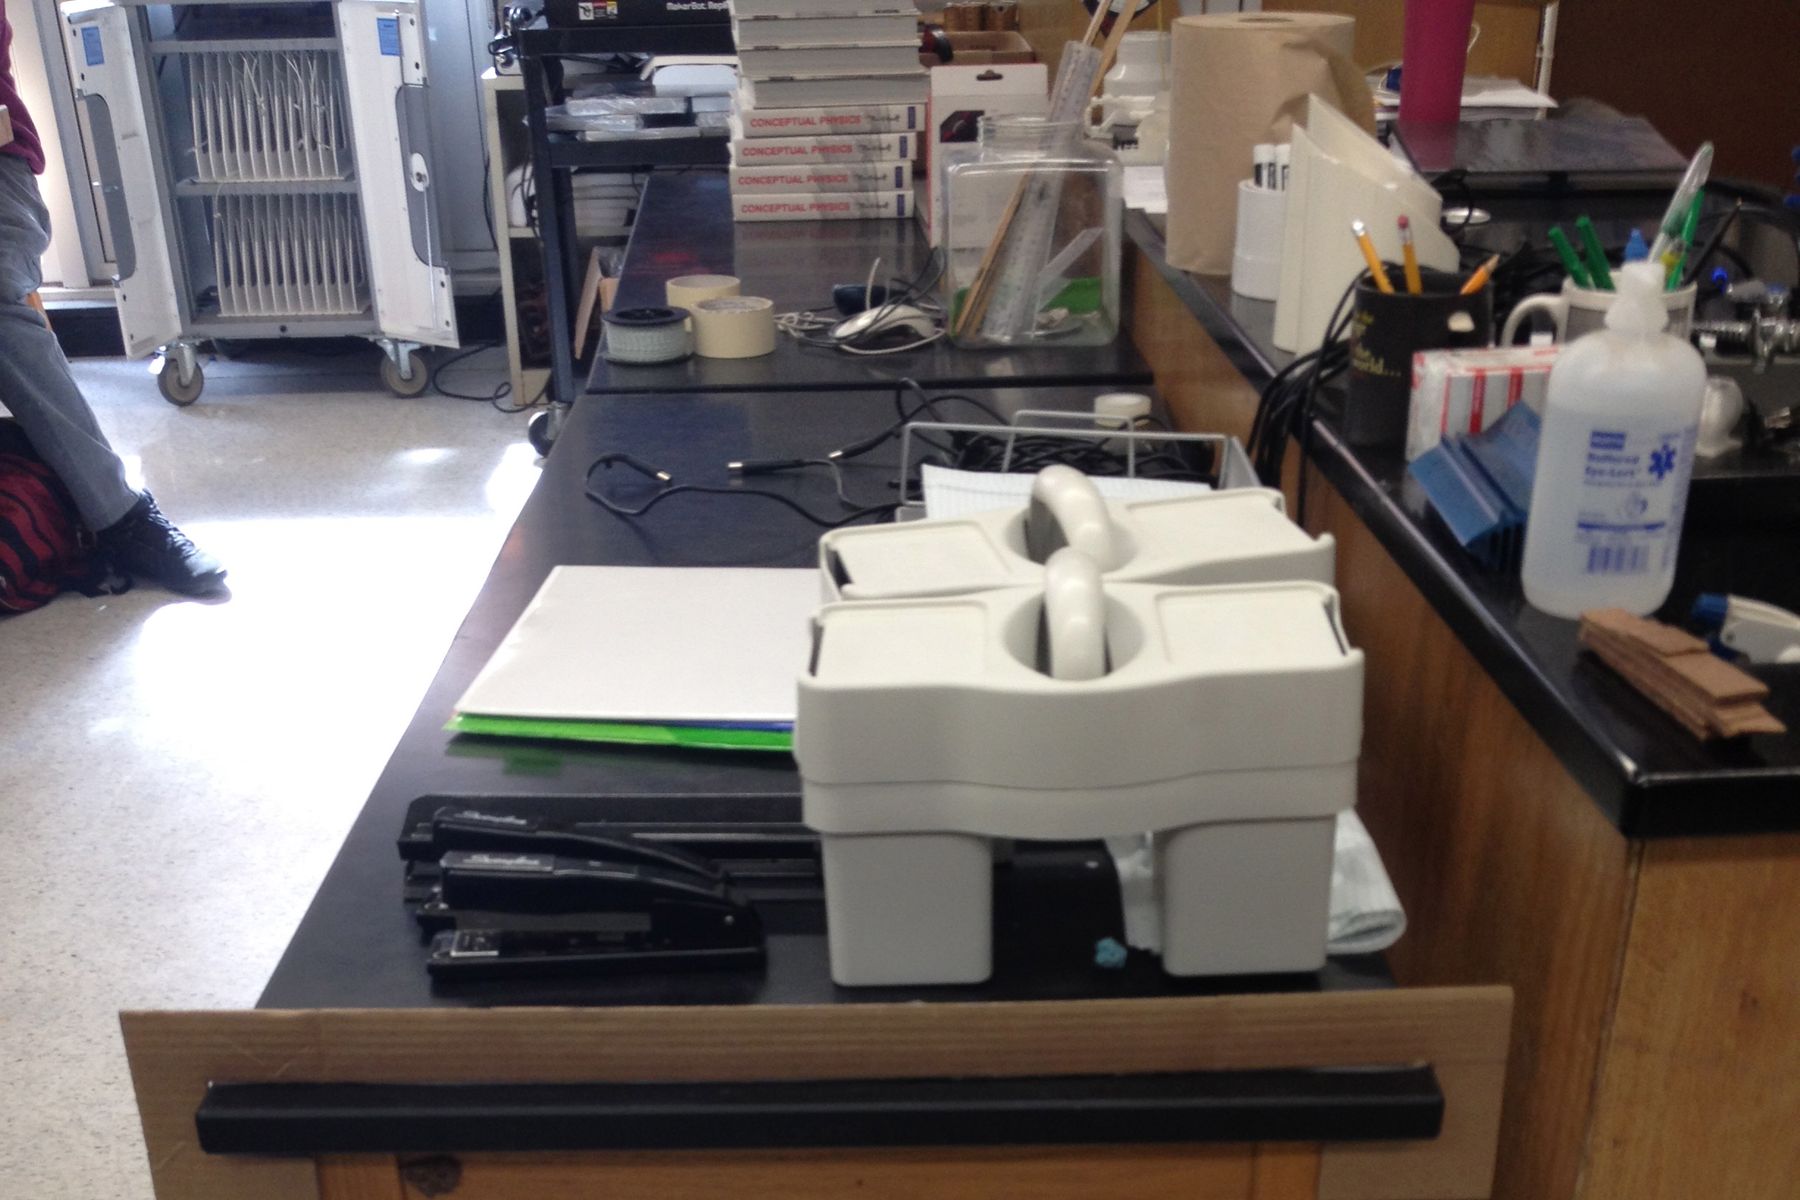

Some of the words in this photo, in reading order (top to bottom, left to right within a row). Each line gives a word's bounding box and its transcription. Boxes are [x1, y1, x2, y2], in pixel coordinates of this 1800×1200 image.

[750, 116, 817, 128] CONCEPTUAL
[819, 114, 862, 126] PHYSICS
[742, 145, 809, 157] CONCEPTUAL
[811, 144, 853, 155] PHYSICS
[738, 174, 804, 186] CONCEPTUAL
[806, 174, 849, 184] PHYSICS
[741, 202, 807, 214] CONCEPTUAL
[809, 201, 850, 212] PHYSICS
